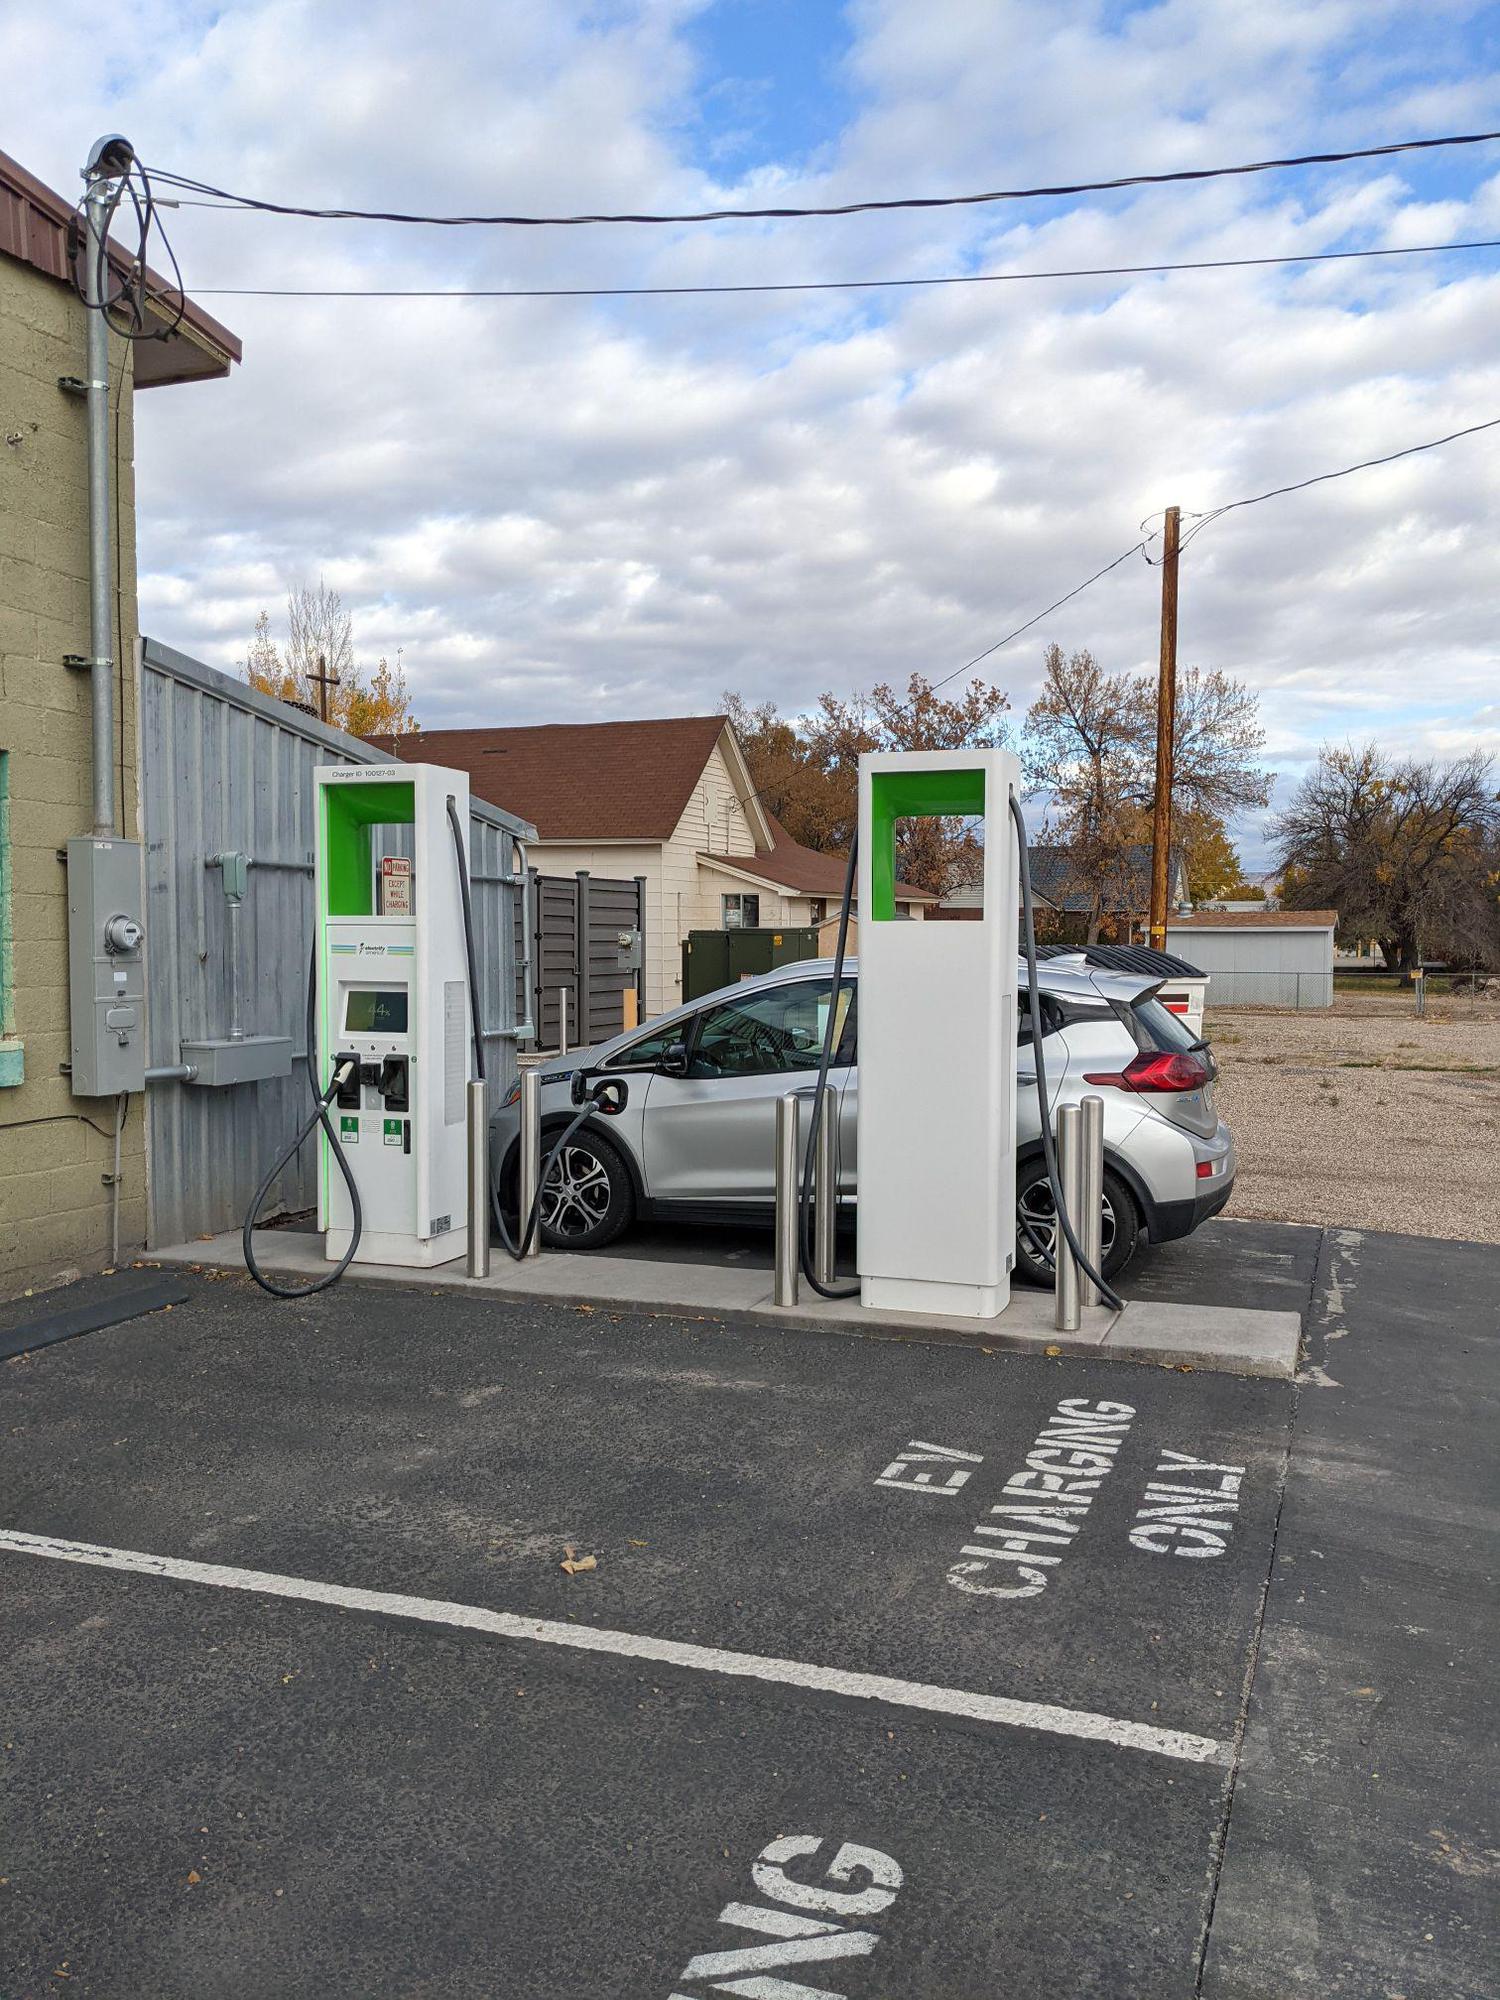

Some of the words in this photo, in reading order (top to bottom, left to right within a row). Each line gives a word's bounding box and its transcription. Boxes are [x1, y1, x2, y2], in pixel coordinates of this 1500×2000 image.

[384, 861, 392, 873] NO
[392, 862, 409, 873] PARKING
[388, 879, 405, 888] EXCEPT
[386, 900, 409, 909] CHARGING
[390, 890, 405, 899] WHILE
[873, 1439, 984, 1495] EV
[946, 1398, 1137, 1599] CHARGING
[1128, 1449, 1246, 1558] ONLY
[667, 1834, 904, 2000] NG
